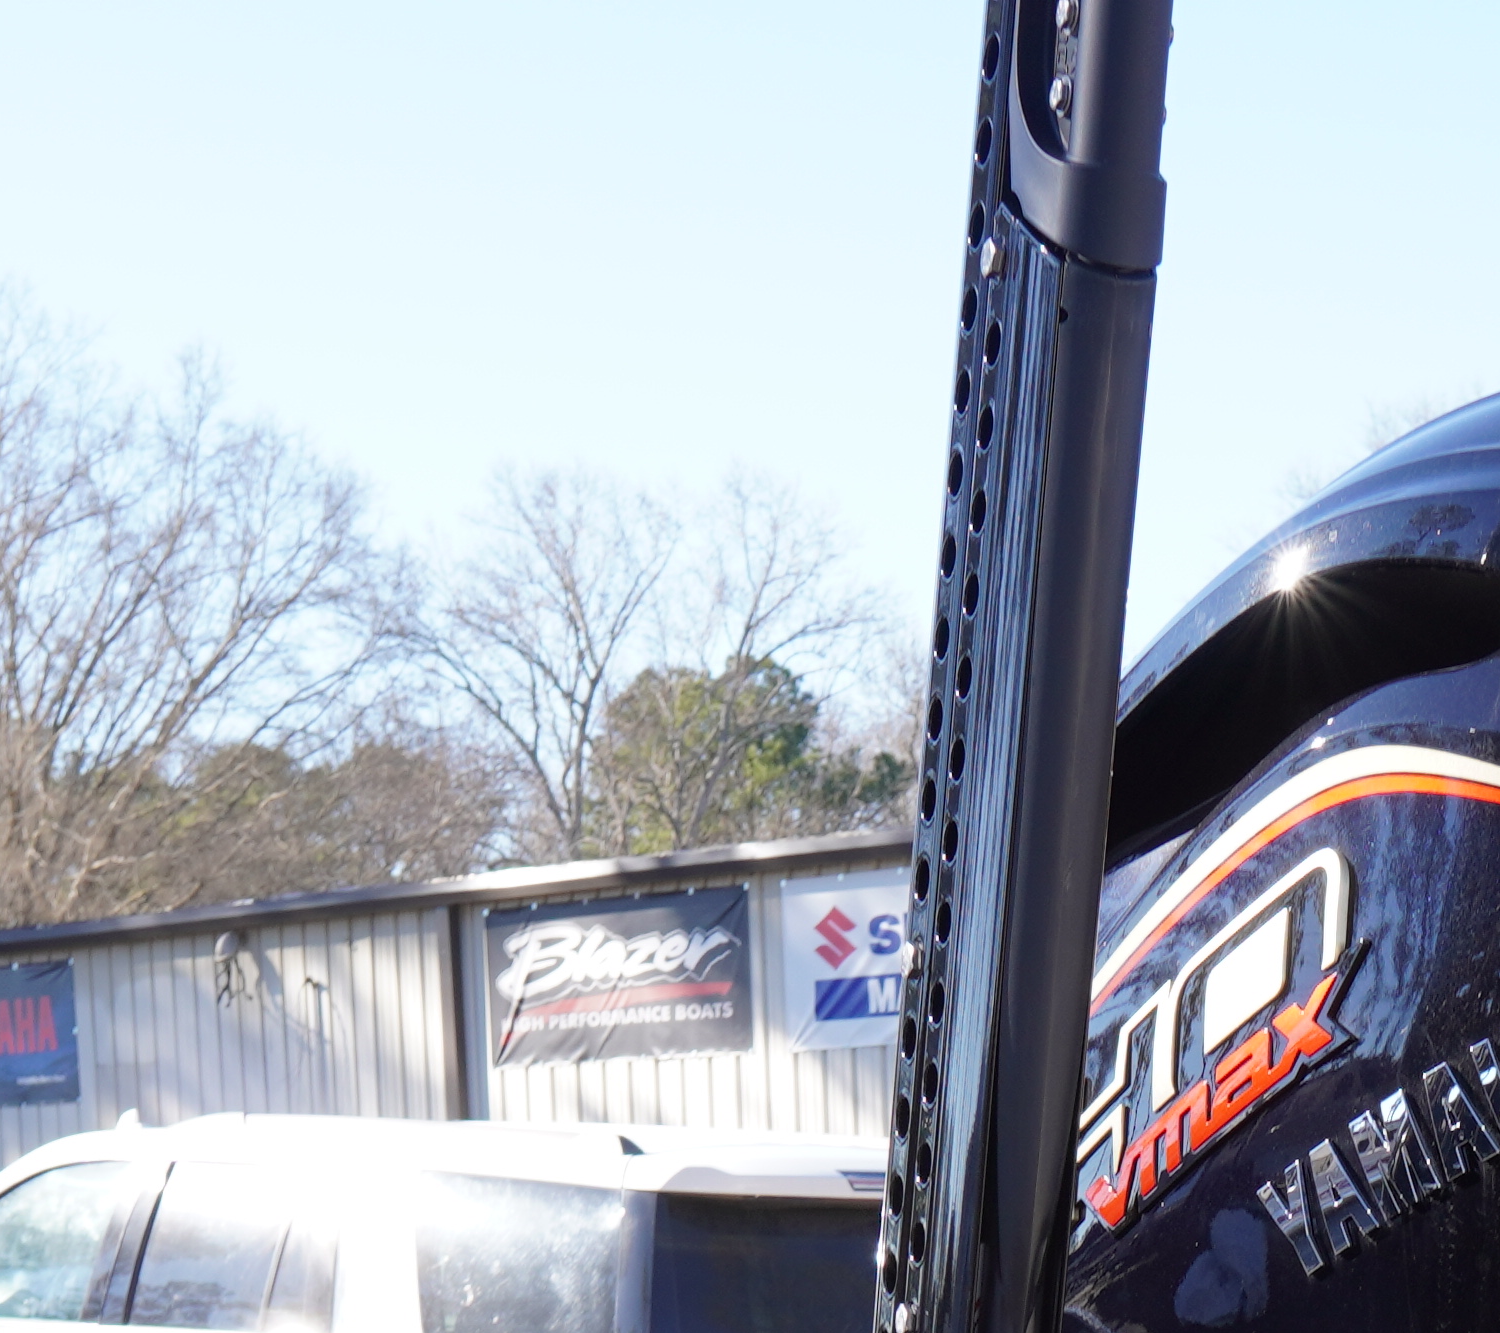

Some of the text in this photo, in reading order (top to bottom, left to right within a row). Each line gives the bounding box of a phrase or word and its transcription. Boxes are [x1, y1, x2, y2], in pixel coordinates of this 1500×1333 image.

[496, 924, 738, 1000] Blazer
[503, 1001, 734, 1033] HIGH PERFORMANCE BOATS
